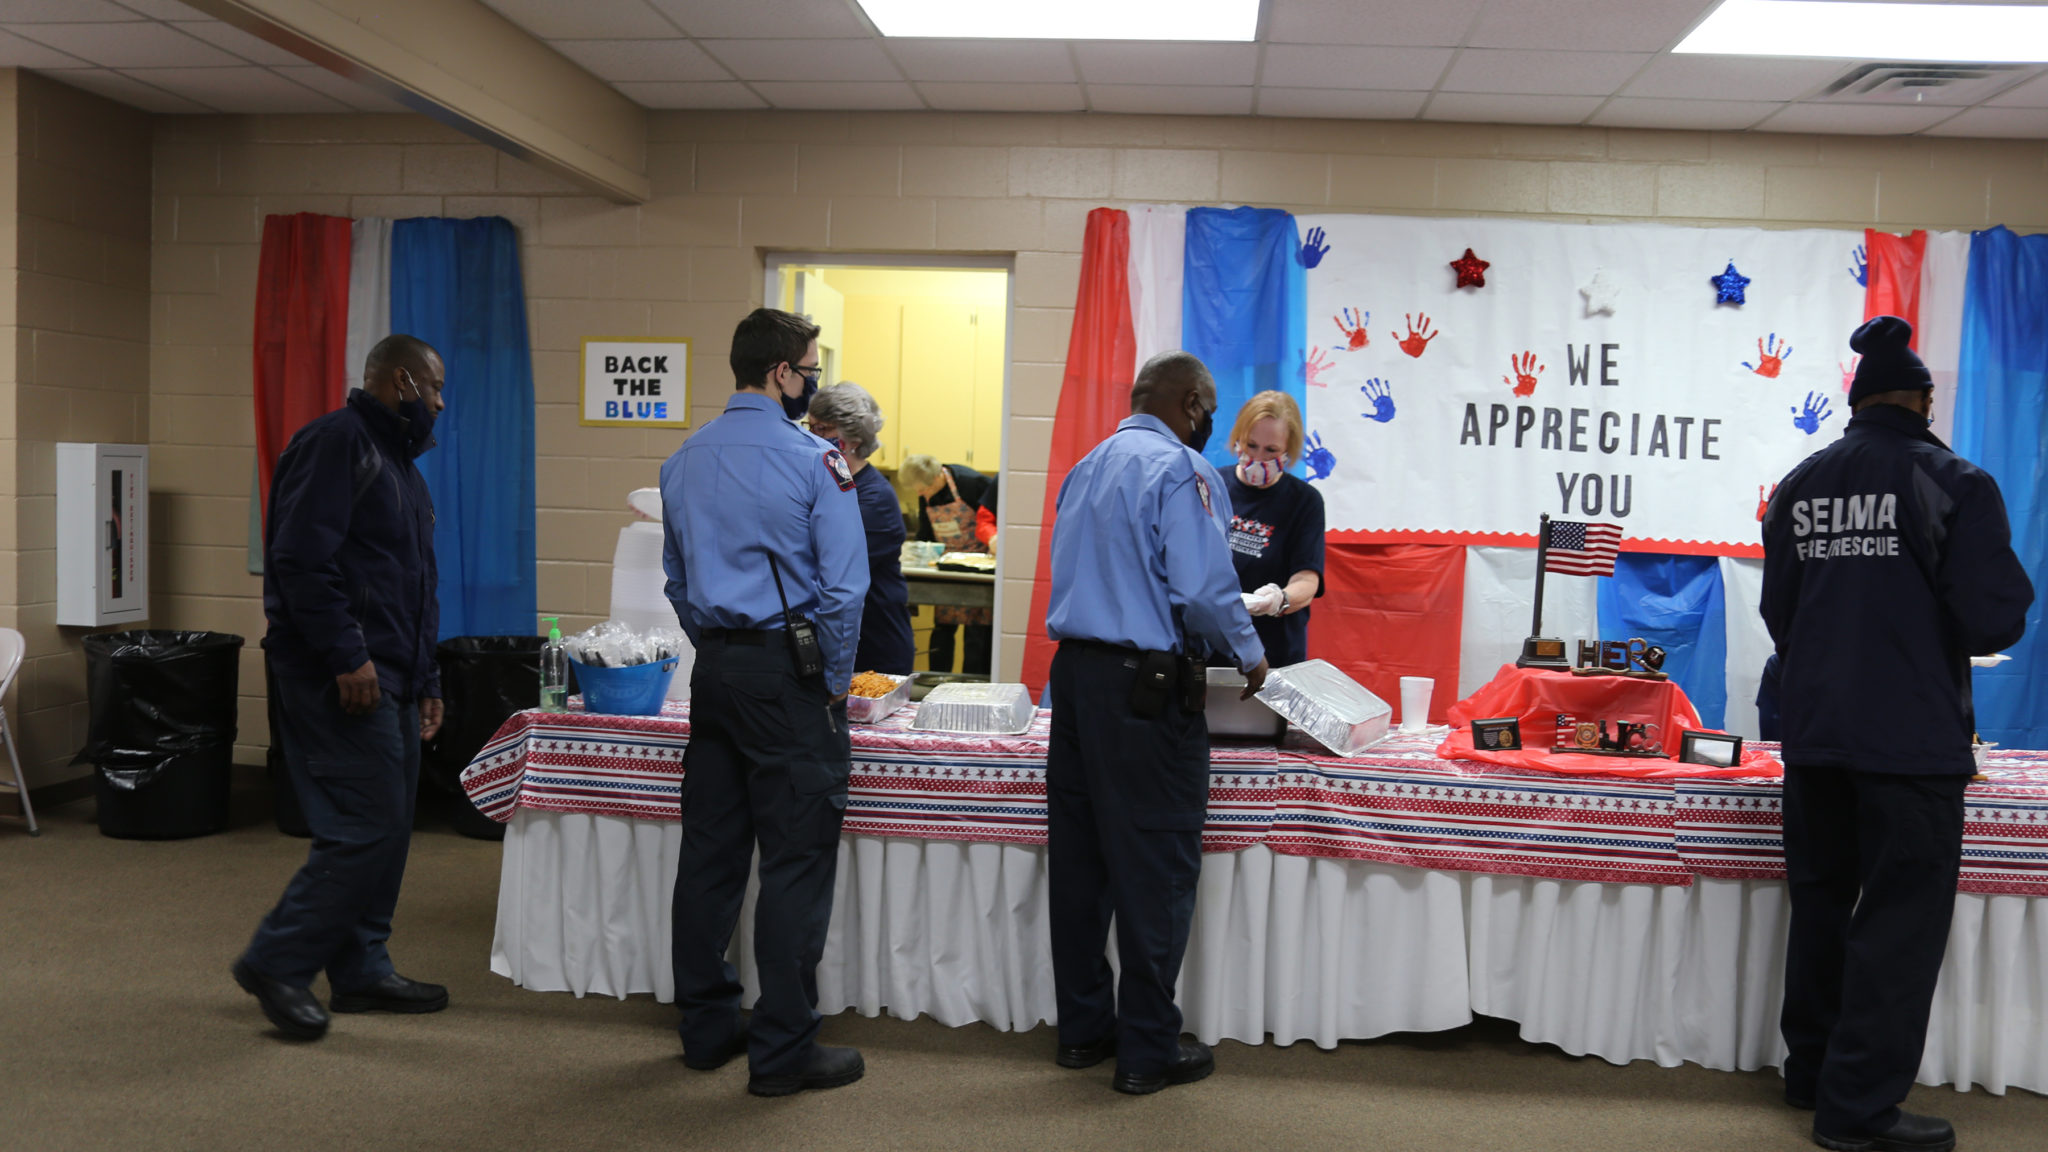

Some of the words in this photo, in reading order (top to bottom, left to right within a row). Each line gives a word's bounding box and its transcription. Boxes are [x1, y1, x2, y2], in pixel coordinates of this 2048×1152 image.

[605, 355, 668, 373] BACK
[1567, 343, 1620, 386] WE
[605, 400, 668, 418] BLUE
[613, 379, 661, 396] THE
[1460, 402, 1721, 460] APPRECIATE
[1556, 472, 1632, 518] YOU
[1792, 493, 1897, 537] SELMA
